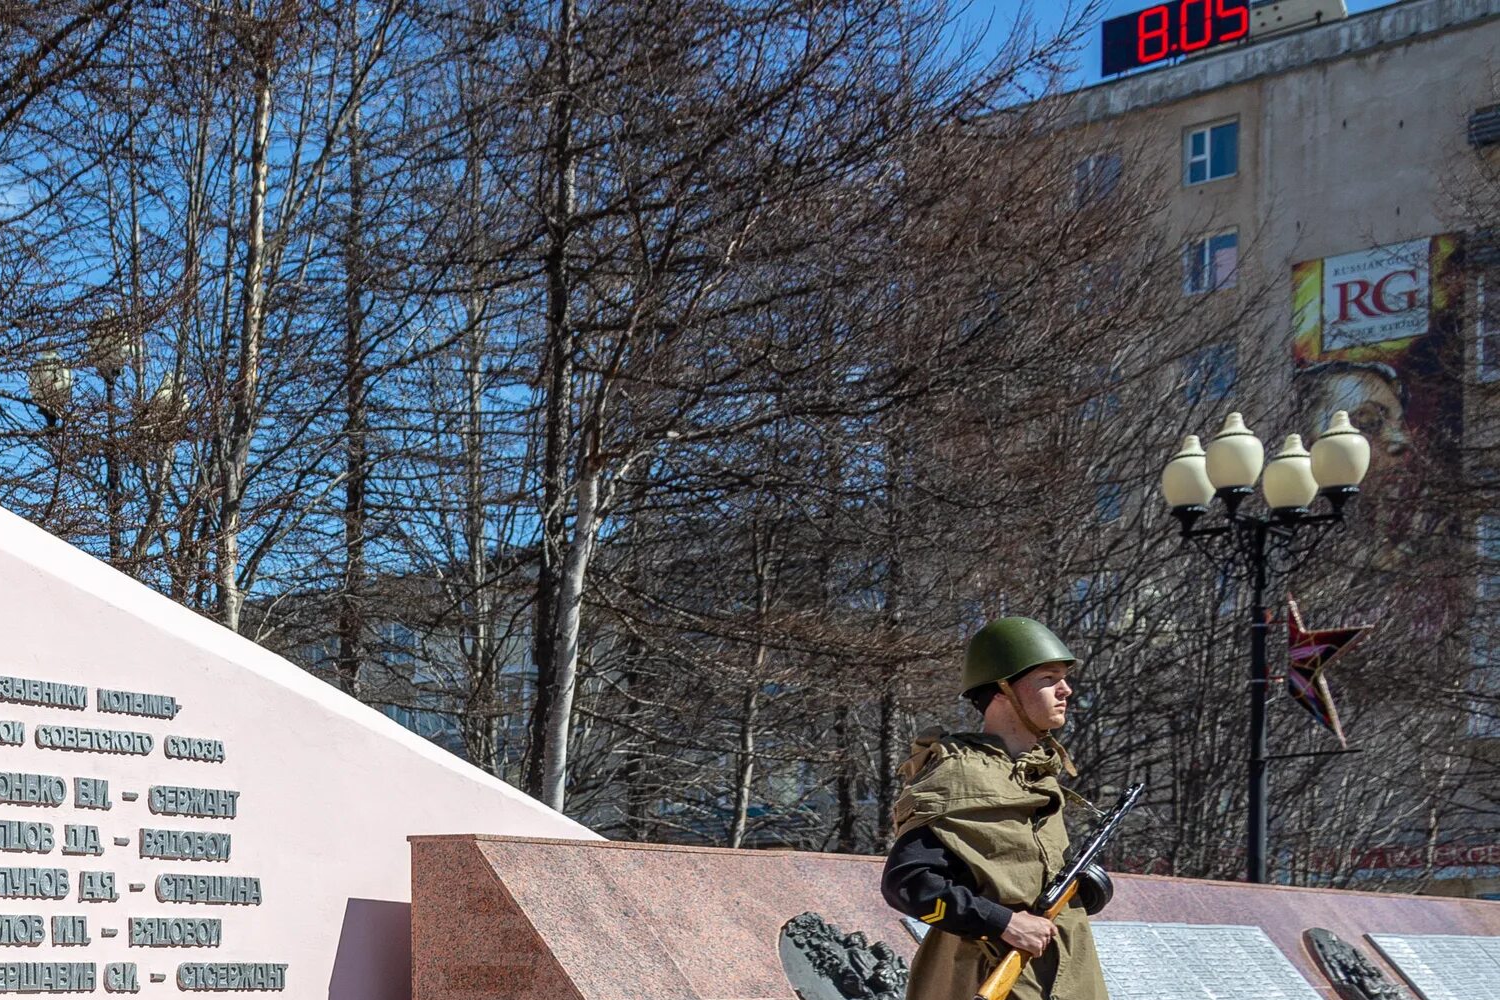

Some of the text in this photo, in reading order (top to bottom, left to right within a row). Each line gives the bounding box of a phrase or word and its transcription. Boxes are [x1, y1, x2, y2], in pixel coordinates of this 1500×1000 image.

[1137, 0, 1250, 64] 8.05
[1332, 269, 1420, 325] RG
[35, 724, 155, 757] СОВЕТСКОГО
[164, 735, 226, 764] СОЮЗА
[148, 785, 240, 820] СЕРЖАНТ
[139, 828, 231, 863] РЯДОВОЙ
[155, 873, 262, 906] СТАРШИНА
[128, 917, 222, 948] РЯДОВОЙ
